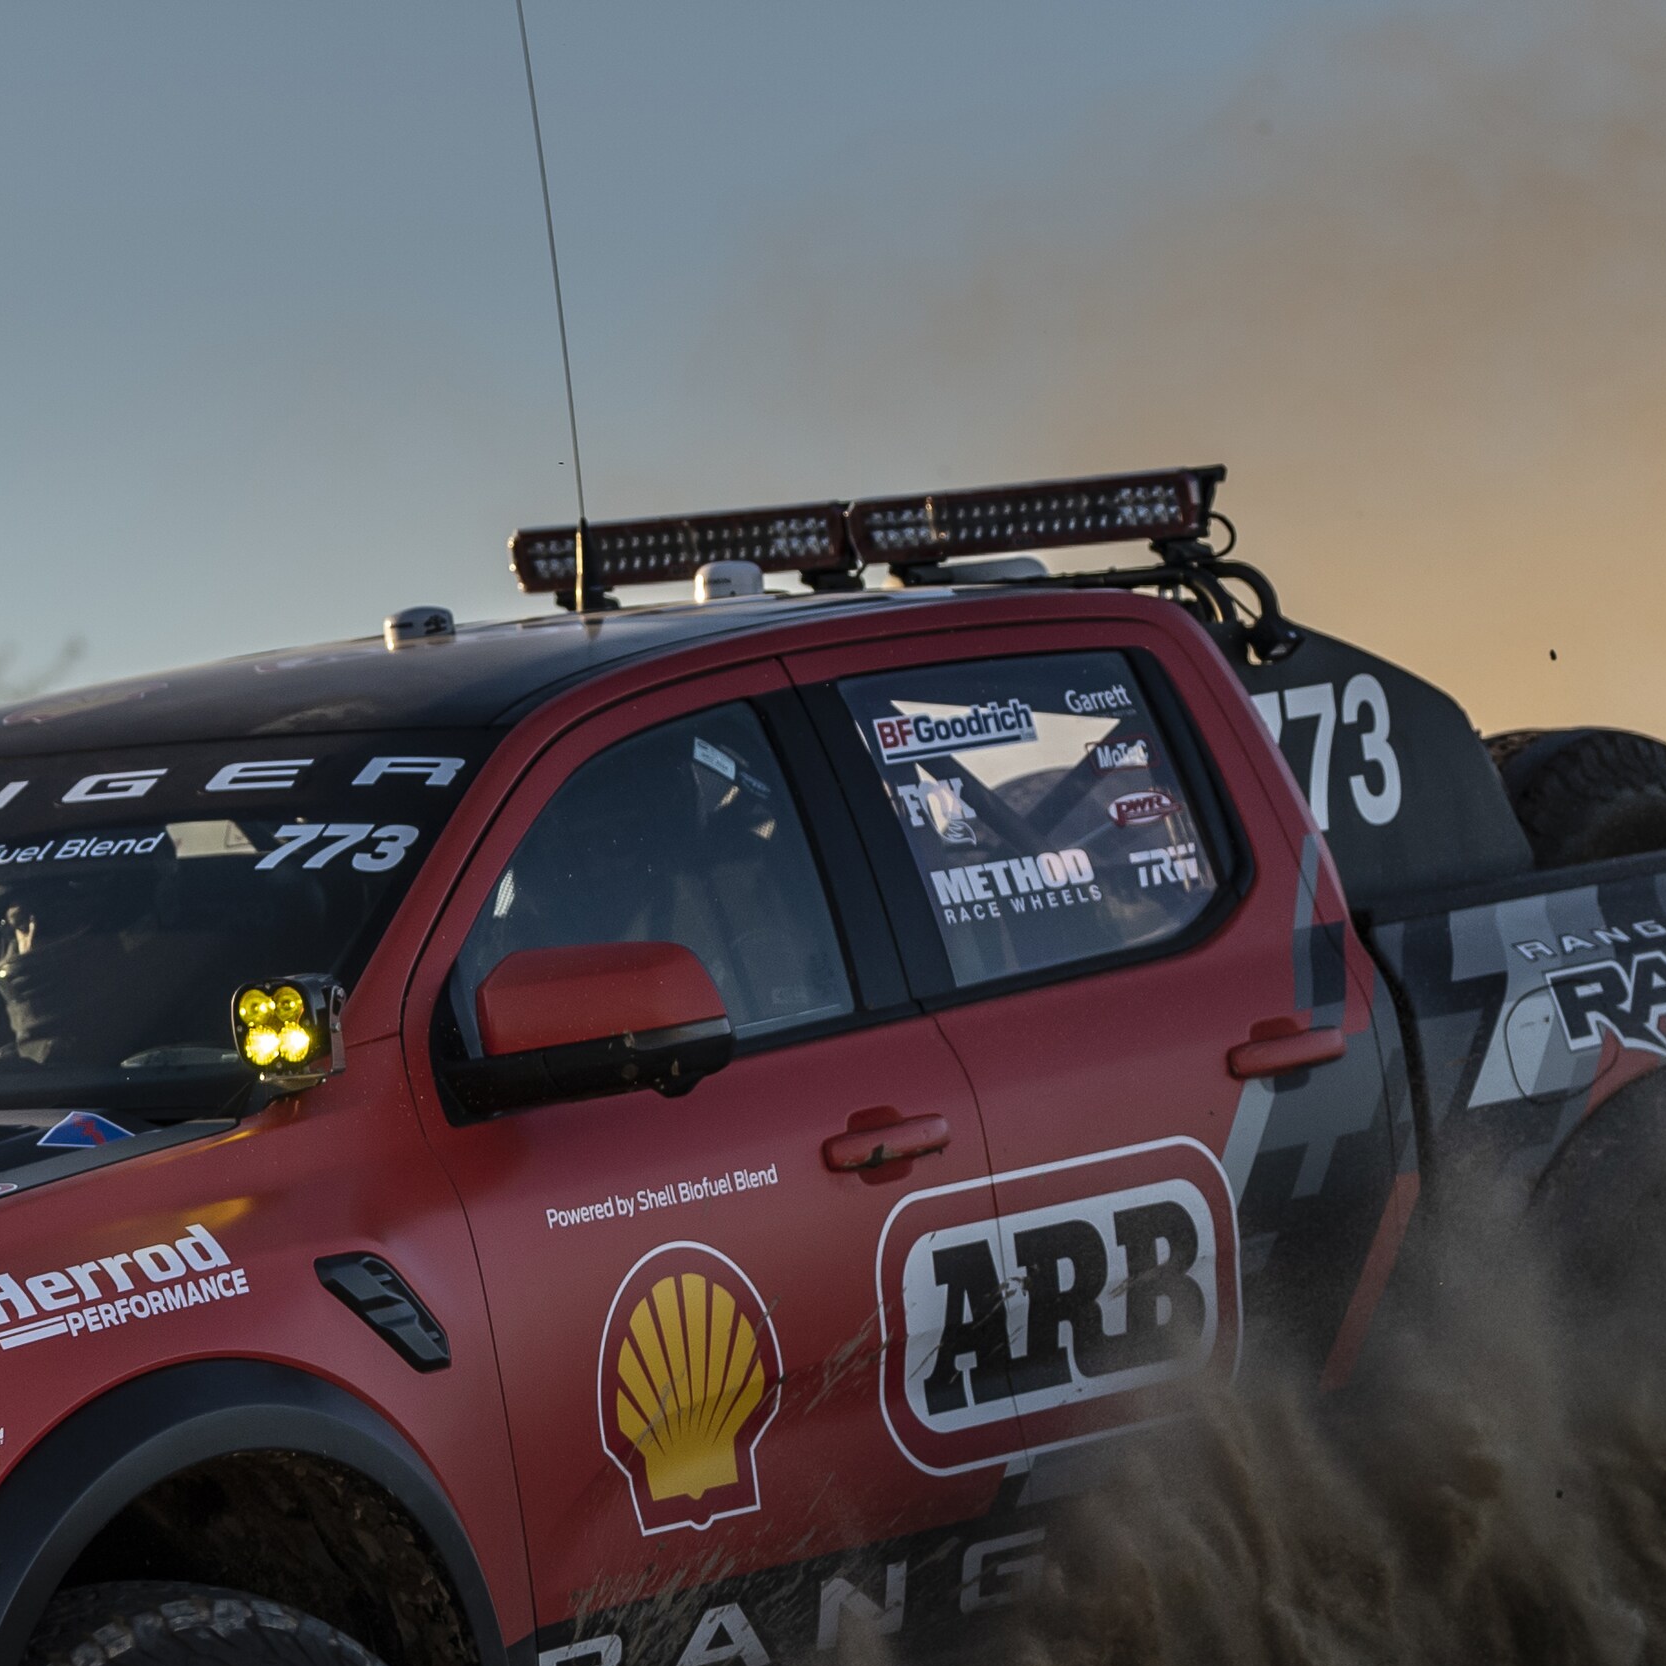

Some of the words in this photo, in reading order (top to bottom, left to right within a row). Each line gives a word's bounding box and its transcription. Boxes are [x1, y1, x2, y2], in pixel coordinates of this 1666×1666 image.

[1065, 684, 1133, 713] Garrett
[877, 701, 1033, 749] BFGoodrich
[54, 832, 166, 860] Blend
[254, 823, 420, 873] 773
[930, 848, 1095, 906] METHOD
[944, 901, 1001, 925] RACE
[1010, 884, 1103, 915] WHEELS
[545, 1196, 615, 1229] Powered
[615, 1195, 635, 1218] by
[636, 1184, 678, 1212] Shell
[678, 1173, 733, 1203] Biofuel
[733, 1163, 779, 1192] Blend
[65, 1268, 250, 1337] PERFORMANCE
[923, 1200, 1207, 1417] ARB
